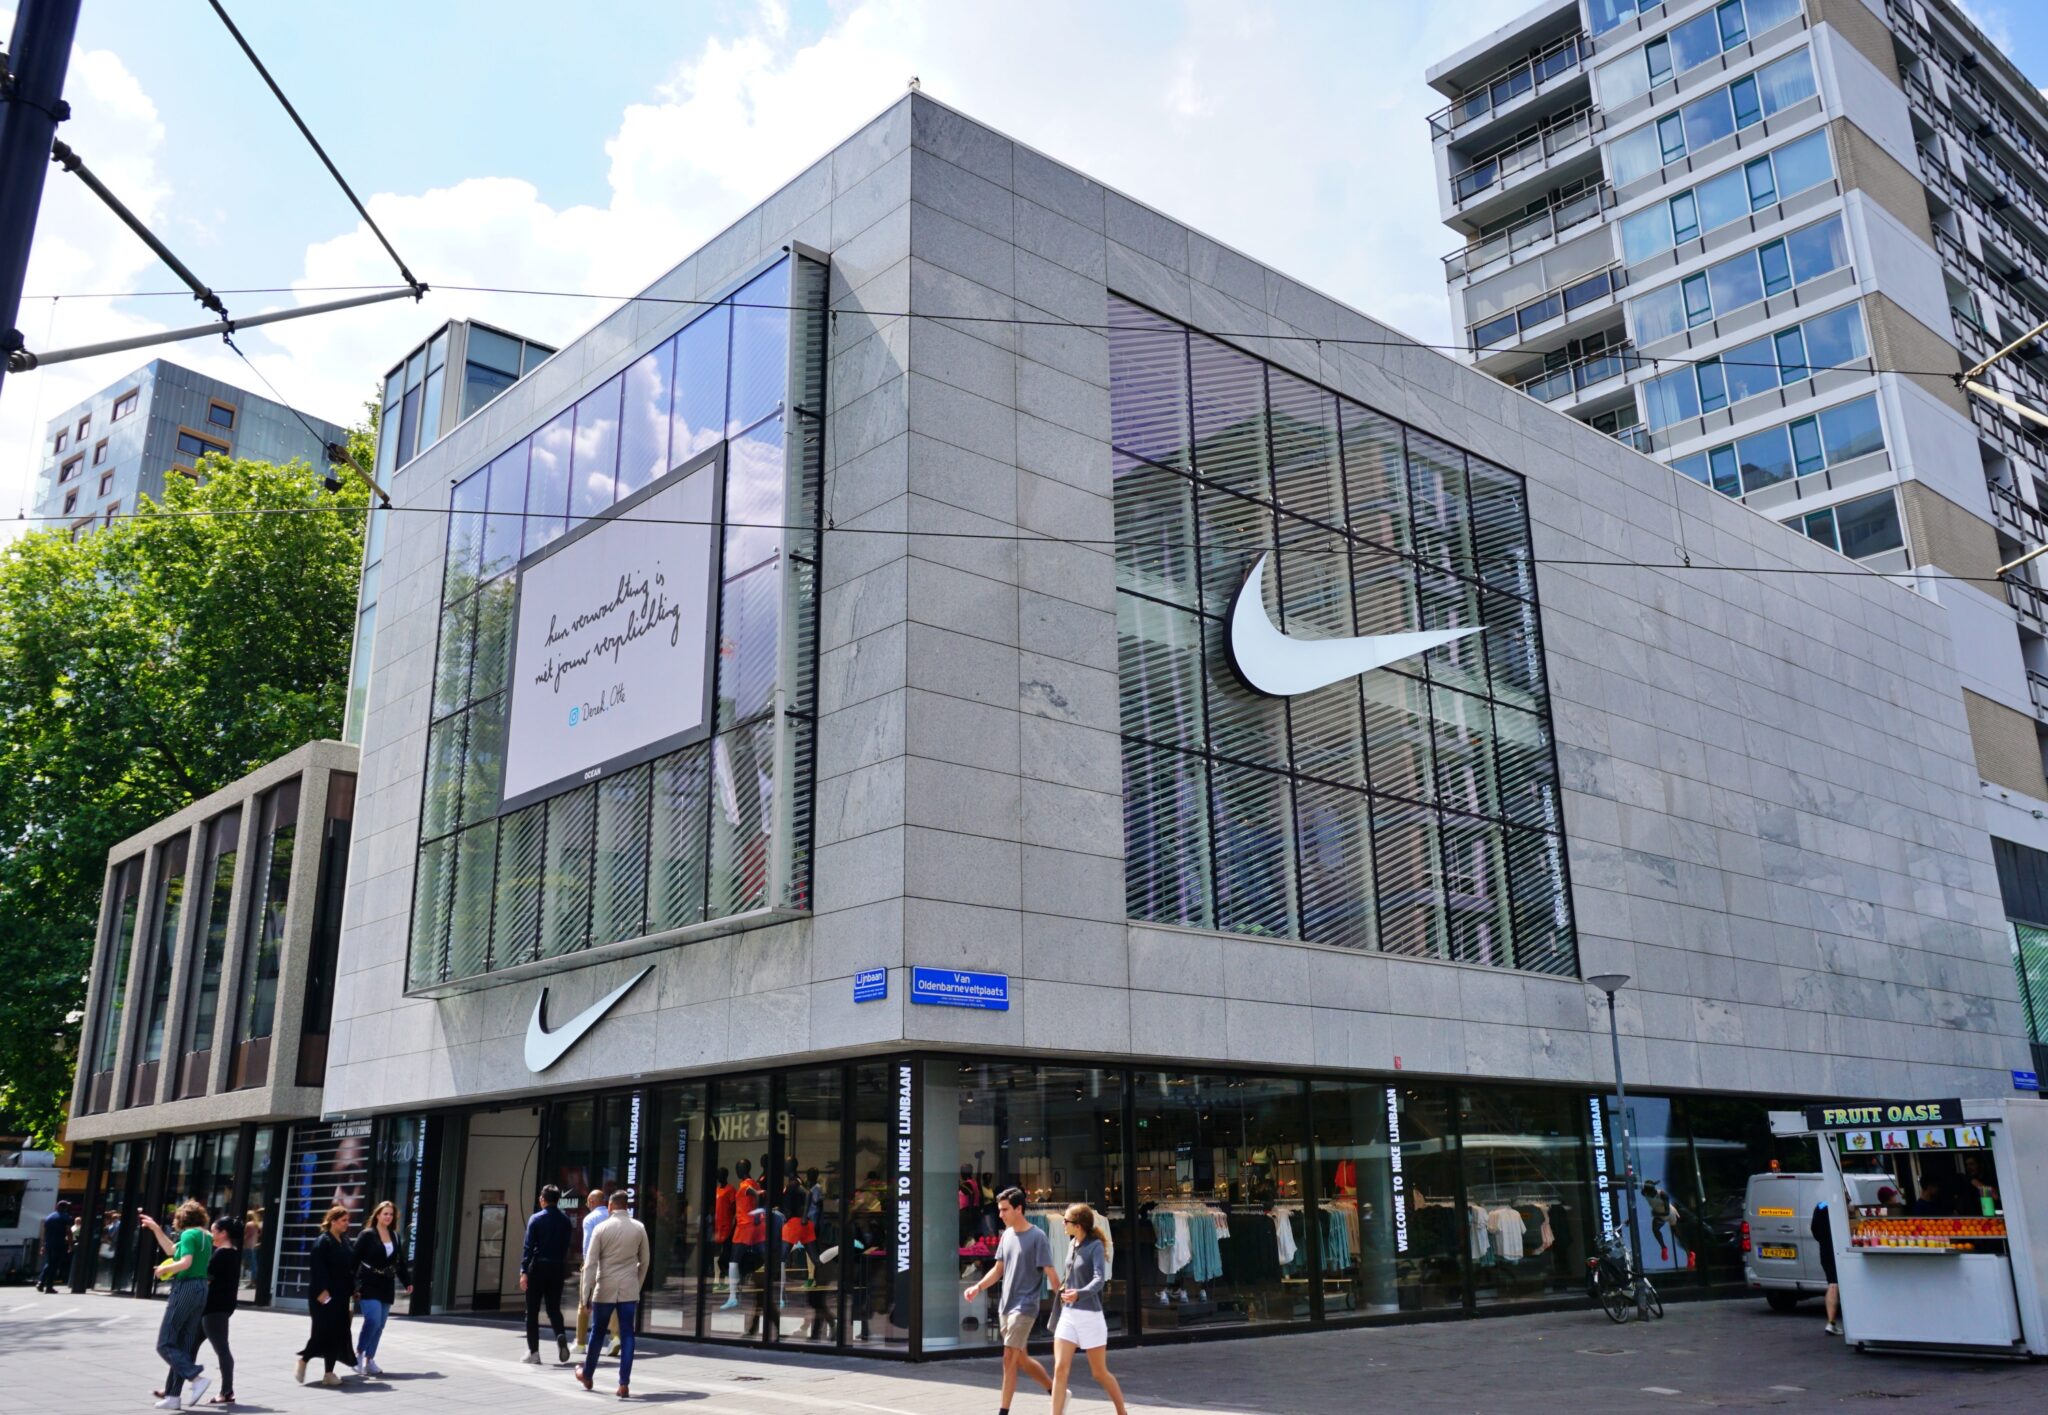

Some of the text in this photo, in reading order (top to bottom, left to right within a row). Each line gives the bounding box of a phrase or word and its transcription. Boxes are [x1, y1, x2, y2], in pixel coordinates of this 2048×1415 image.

[544, 560, 665, 648] hun verwachting is
[554, 650, 591, 694] jouw
[593, 592, 681, 665] verplichting
[584, 767, 602, 781] OCEAN
[855, 970, 883, 988] Lijnbaan
[918, 979, 1004, 997] Oldenbarneveltplaats
[953, 973, 971, 984] Van
[1822, 1103, 1943, 1126] FRUIT OASE
[897, 1066, 912, 1273] WELCOME TO NIKE LIJNBAAN
[1387, 1088, 1408, 1253] WELCOME TO NIKE LIJNBAAN
[1589, 1098, 1614, 1242] WELCOME TO NIKE LIJNBAAN
